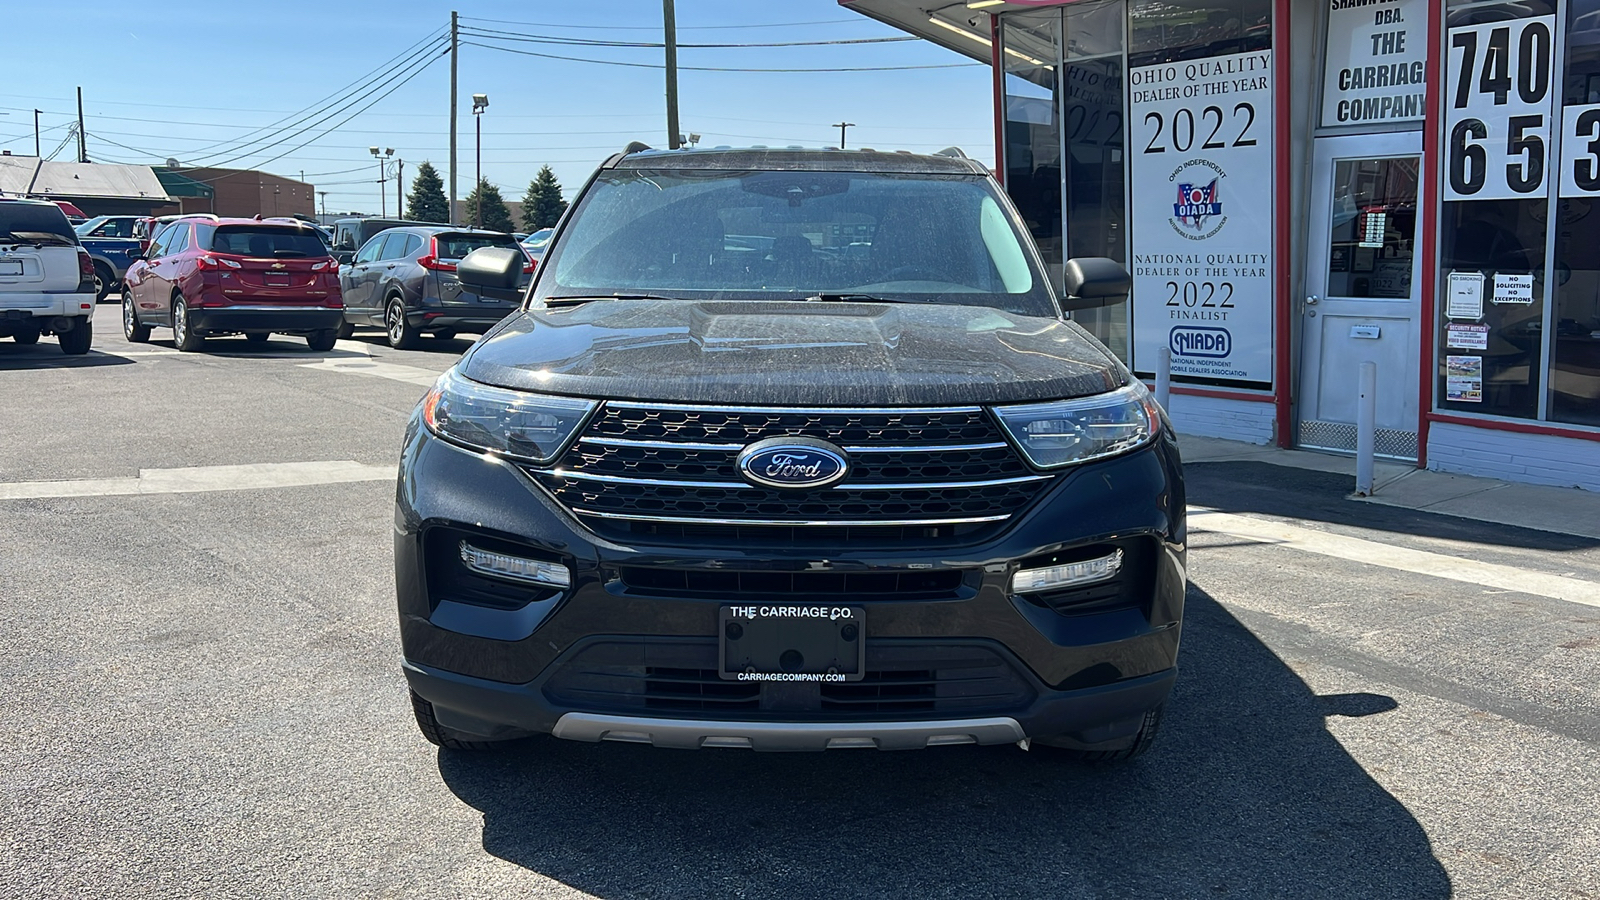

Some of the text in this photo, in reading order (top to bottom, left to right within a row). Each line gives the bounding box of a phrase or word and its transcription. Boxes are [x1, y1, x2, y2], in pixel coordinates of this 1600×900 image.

[1332, 0, 1377, 10] SHA
[1375, 8, 1404, 25] DBA.
[1371, 31, 1406, 56] THE
[1131, 67, 1177, 85] OHIO
[1185, 54, 1270, 81] QUALITY
[1453, 22, 1551, 109] 740
[1133, 76, 1268, 103] DEALER OF THE YEAR
[1143, 102, 1257, 154] 2022
[1168, 158, 1228, 182] OHIO INDEPENDENT
[1179, 203, 1214, 216] OIADA
[1135, 254, 1268, 265] NATIONAL QUALITY
[1136, 267, 1266, 277] DEALER OF THE YEAR
[1165, 281, 1235, 308] 2022
[1170, 310, 1228, 321] FINALIST
[1174, 332, 1226, 352] NIADA
[1170, 358, 1232, 368] NATIONAL INDEPENDENT
[1211, 368, 1248, 377] ASSOCIATION
[765, 453, 822, 477] Ford
[730, 606, 854, 618] THE CARRIAGE CO.
[737, 673, 846, 682] CARRIAGECOMPANY.COM
